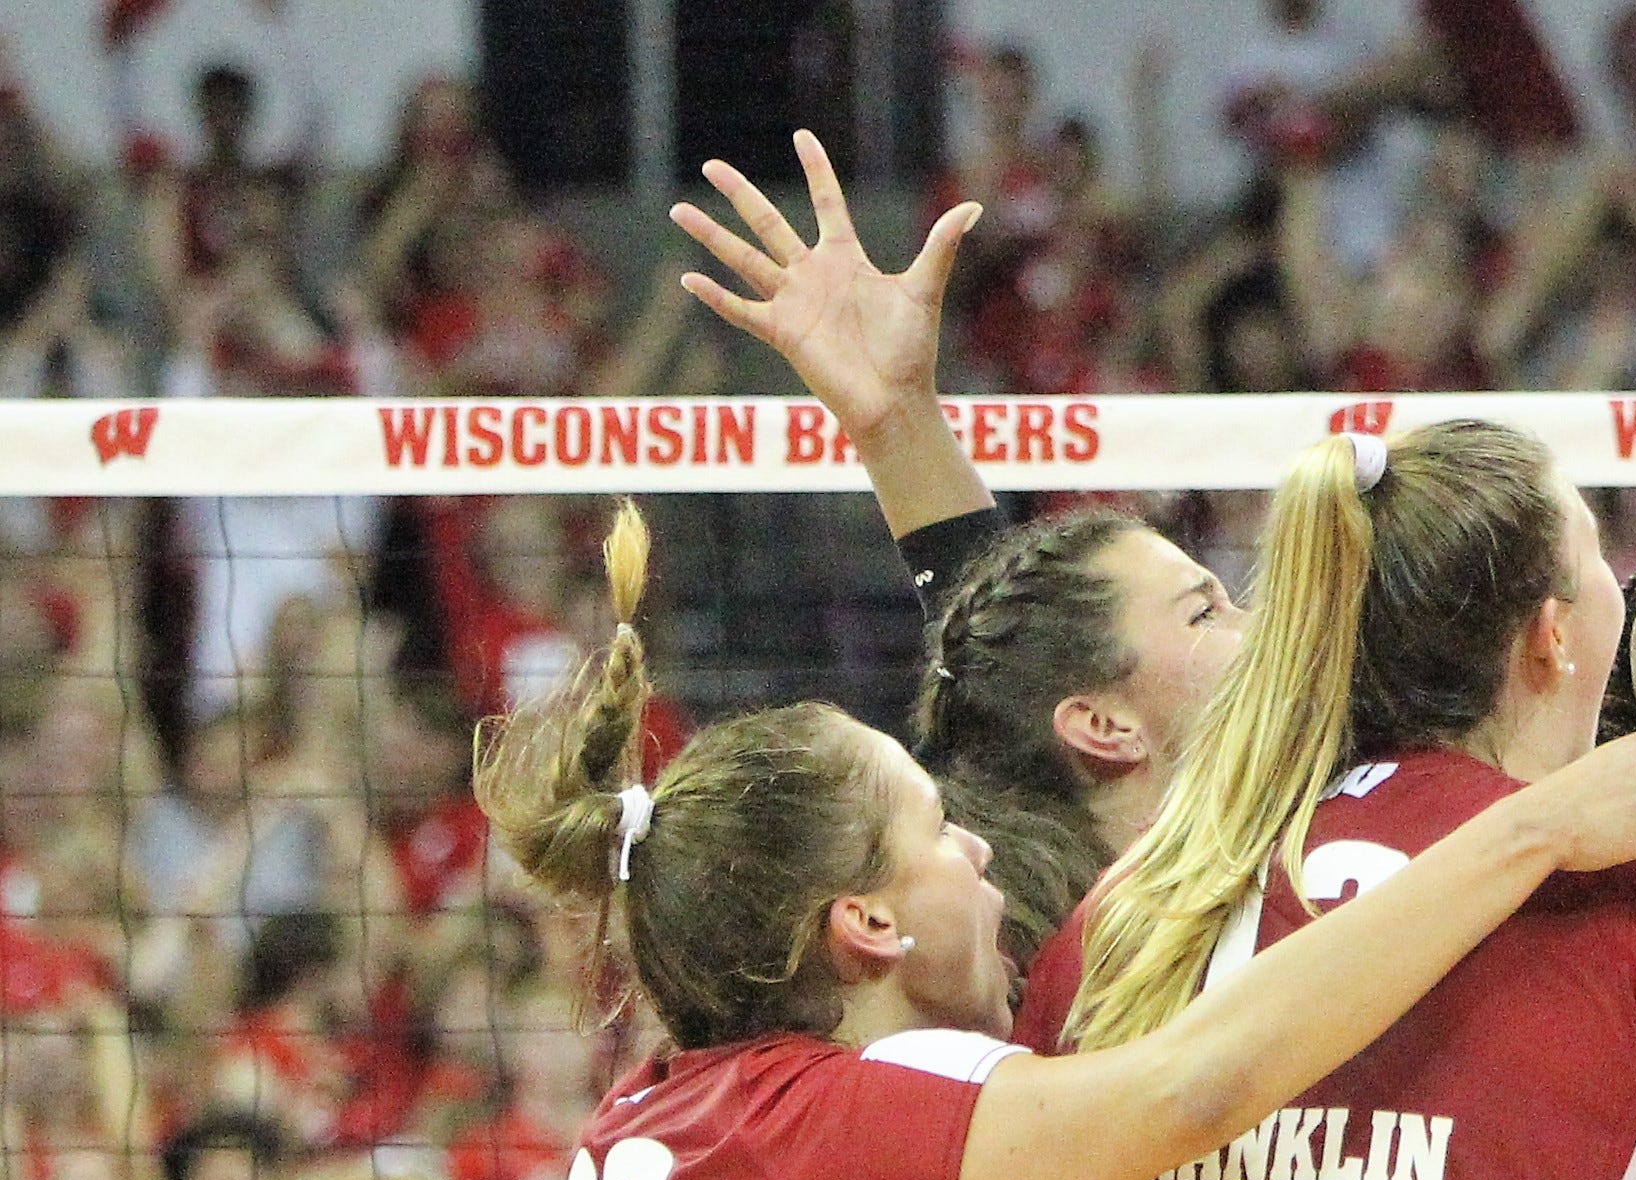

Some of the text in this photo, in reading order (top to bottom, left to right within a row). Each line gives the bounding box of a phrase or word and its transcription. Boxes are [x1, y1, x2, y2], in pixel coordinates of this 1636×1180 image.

[91, 407, 159, 464] W
[379, 403, 1100, 468] WISCONSIN BERS
